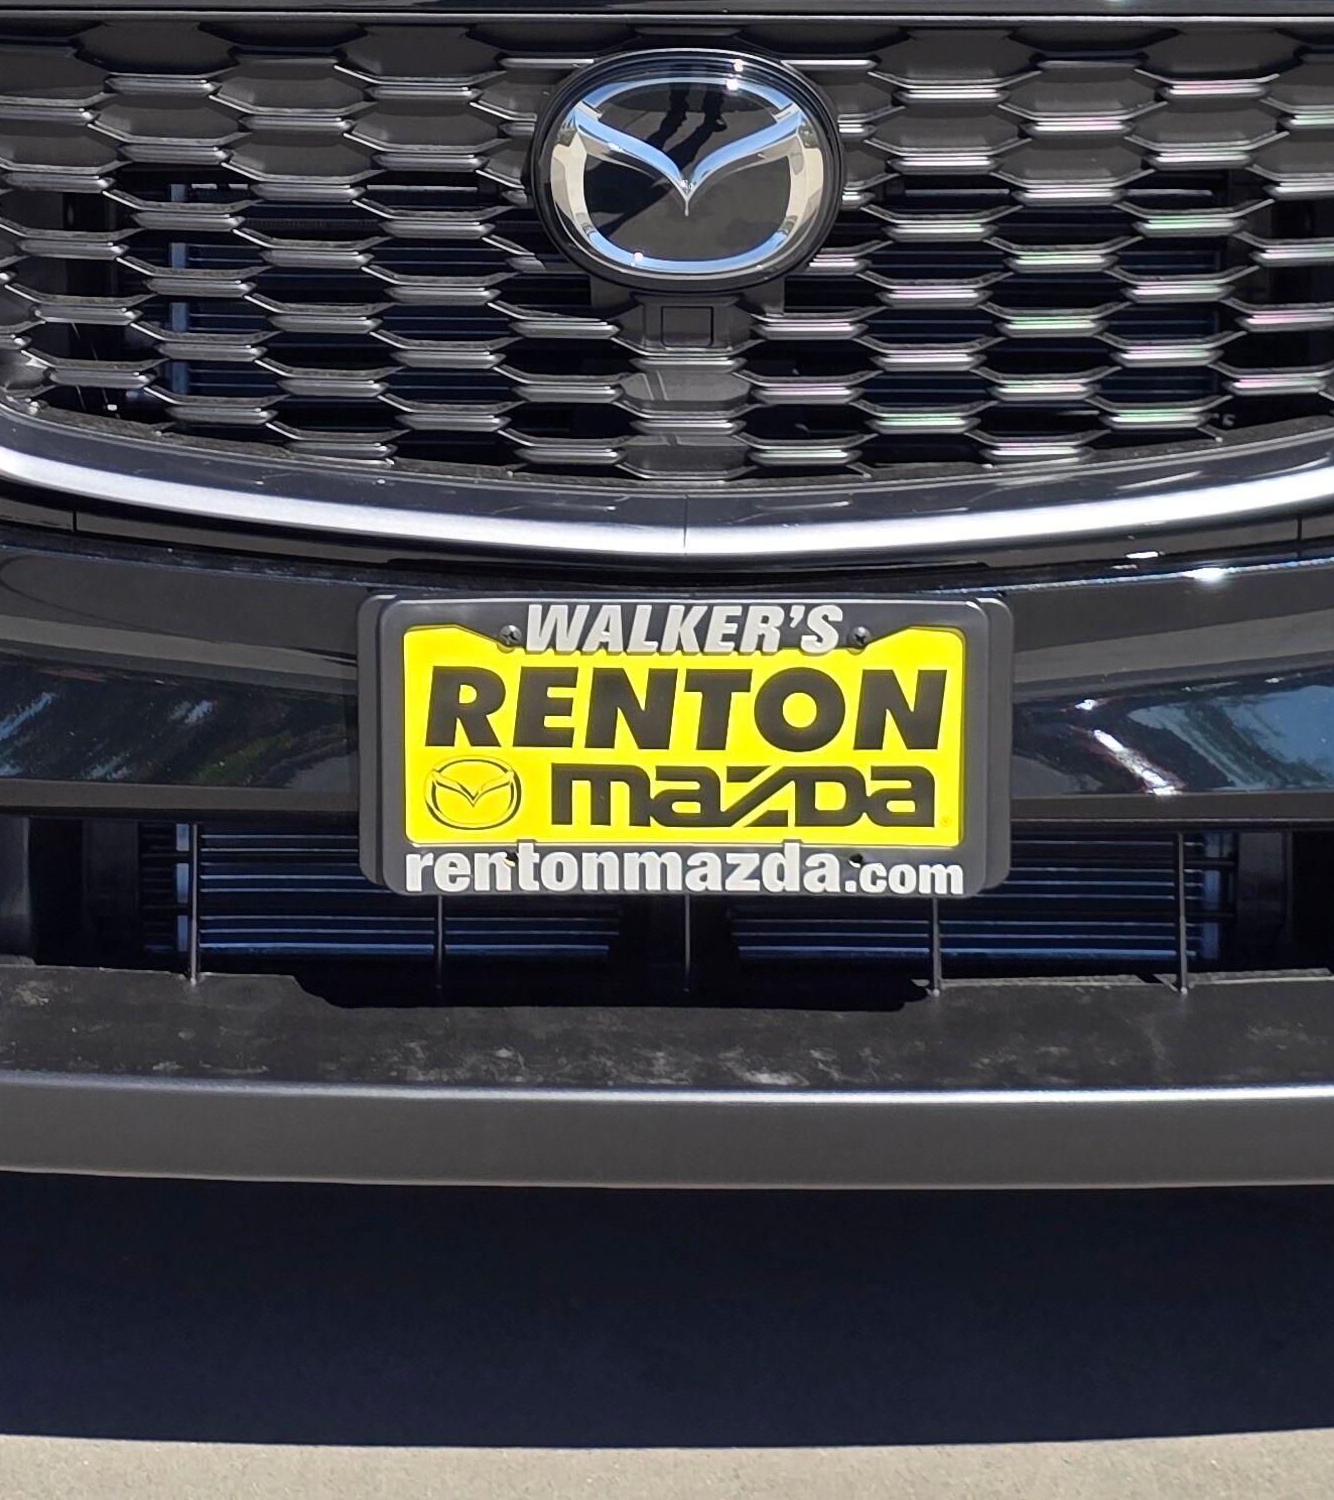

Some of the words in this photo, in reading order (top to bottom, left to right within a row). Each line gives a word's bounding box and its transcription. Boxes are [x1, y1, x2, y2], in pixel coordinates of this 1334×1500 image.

[526, 604, 844, 655] WALKER'S
[424, 665, 948, 753] RENTON
[550, 762, 936, 829] mazda
[404, 840, 965, 896] rentonmazda.com
